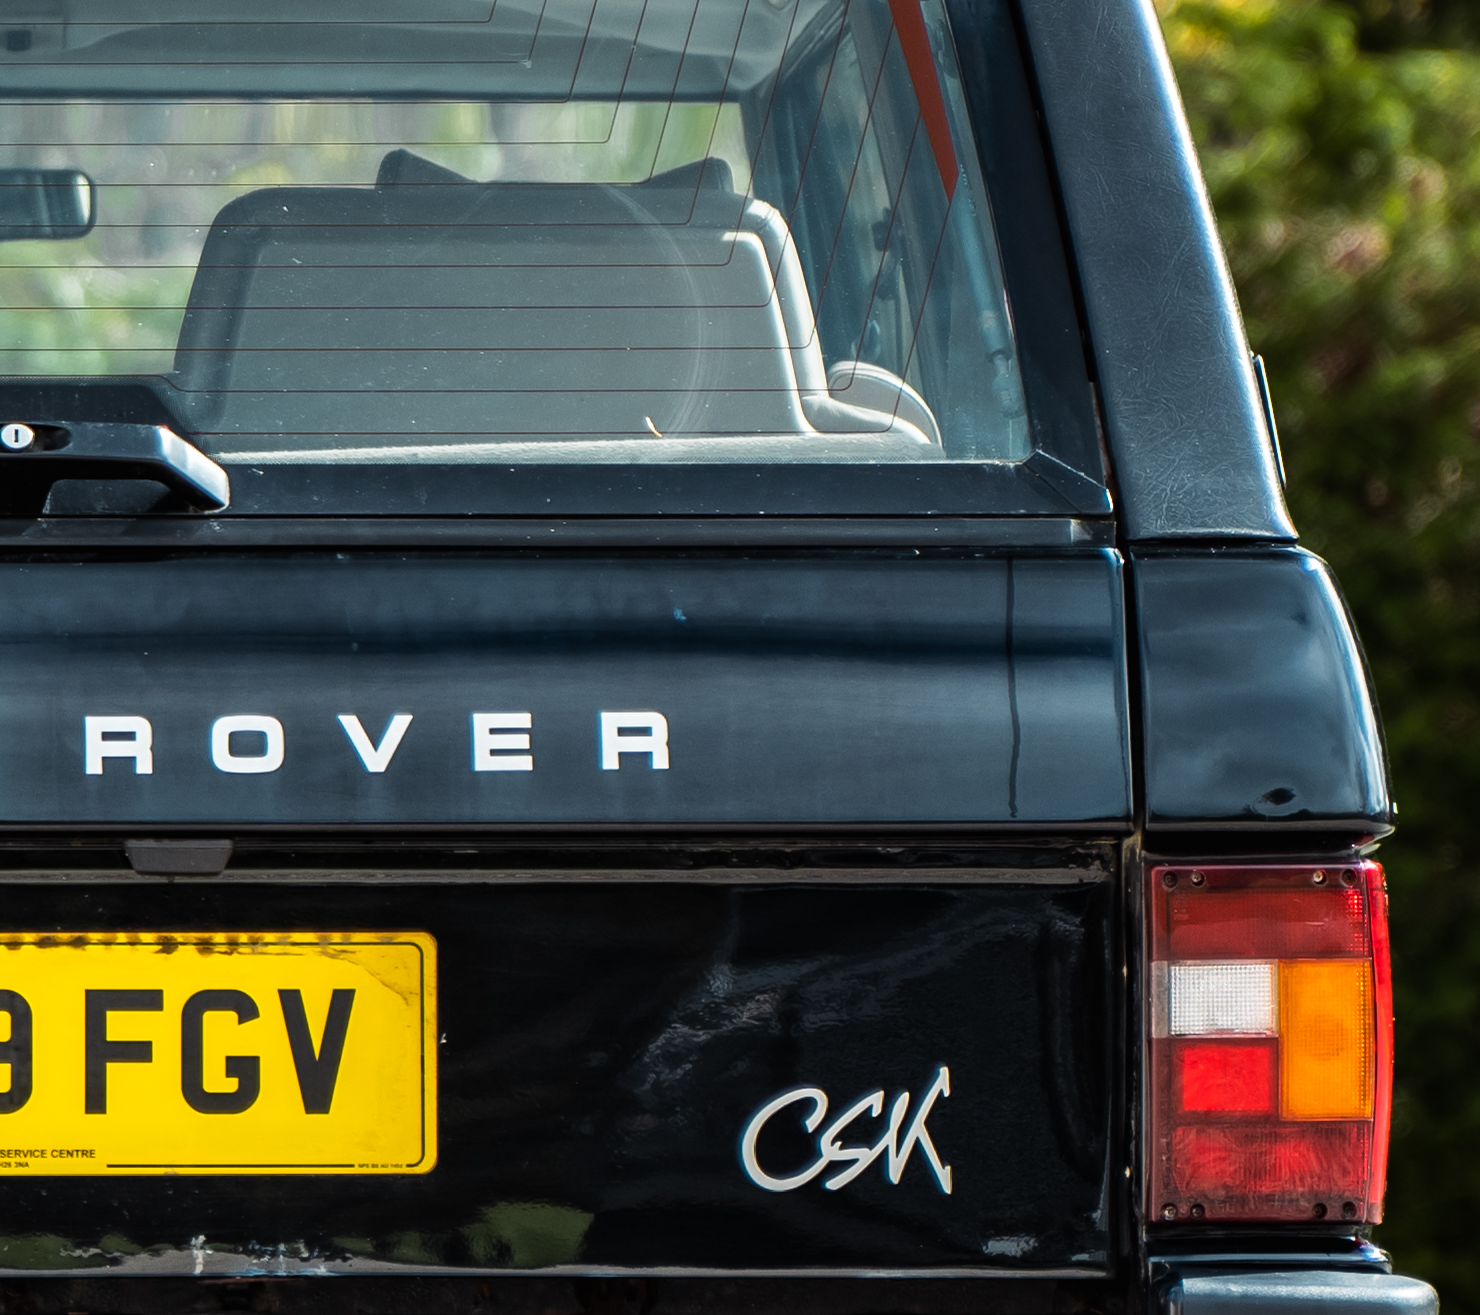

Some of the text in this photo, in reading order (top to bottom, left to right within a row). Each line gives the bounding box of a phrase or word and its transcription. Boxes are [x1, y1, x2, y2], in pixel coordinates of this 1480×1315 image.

[84, 712, 669, 774] ROVER
[85, 989, 355, 1114] FGV
[0, 1149, 47, 1159] SERVICE
[50, 1149, 96, 1159] CENTRE
[742, 1066, 952, 1194] CSK
